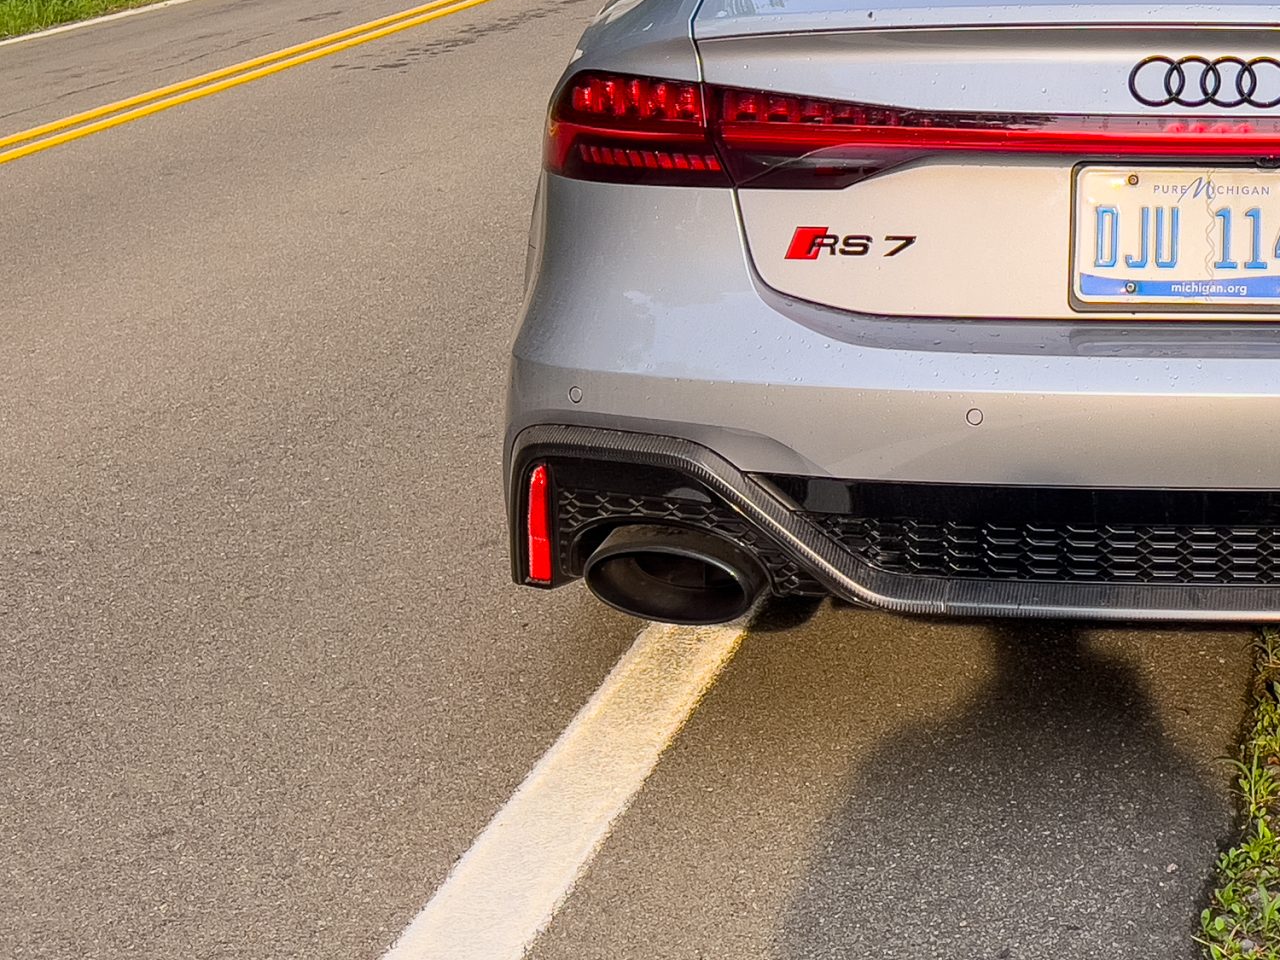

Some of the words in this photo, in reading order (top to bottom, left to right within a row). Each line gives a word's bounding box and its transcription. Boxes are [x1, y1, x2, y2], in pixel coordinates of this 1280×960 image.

[1153, 184, 1187, 194] PURE
[1177, 176, 1270, 203] MICHIGAN
[806, 233, 873, 256] RS
[883, 235, 918, 257] 7
[1094, 206, 1180, 269] DJU
[1171, 282, 1248, 296] michigan.org
